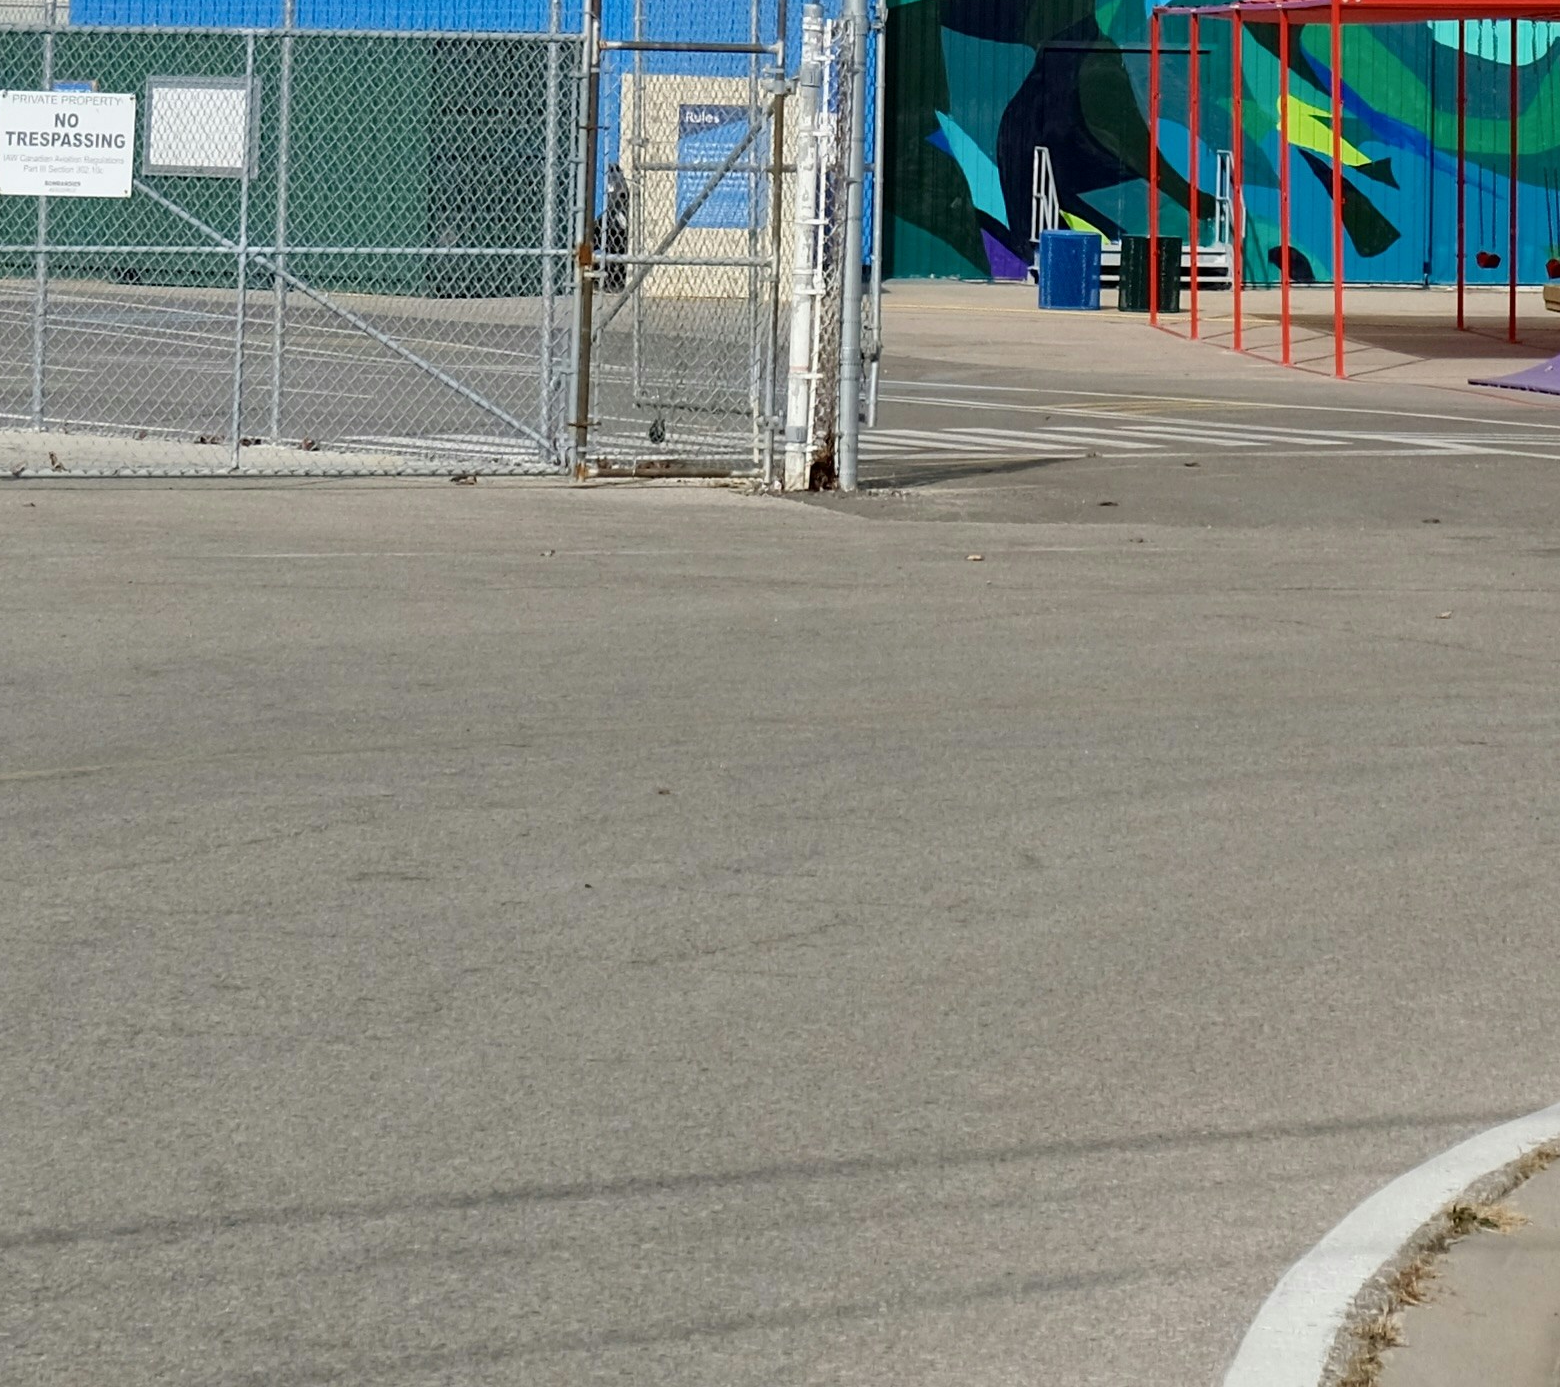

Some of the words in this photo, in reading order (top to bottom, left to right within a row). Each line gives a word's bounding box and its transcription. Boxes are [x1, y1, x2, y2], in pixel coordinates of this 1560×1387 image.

[12, 93, 58, 105] PRIVATE
[61, 95, 122, 107] PROPERTY
[54, 112, 79, 128] NO
[685, 111, 720, 124] Rules
[5, 131, 126, 149] TRESPASSING
